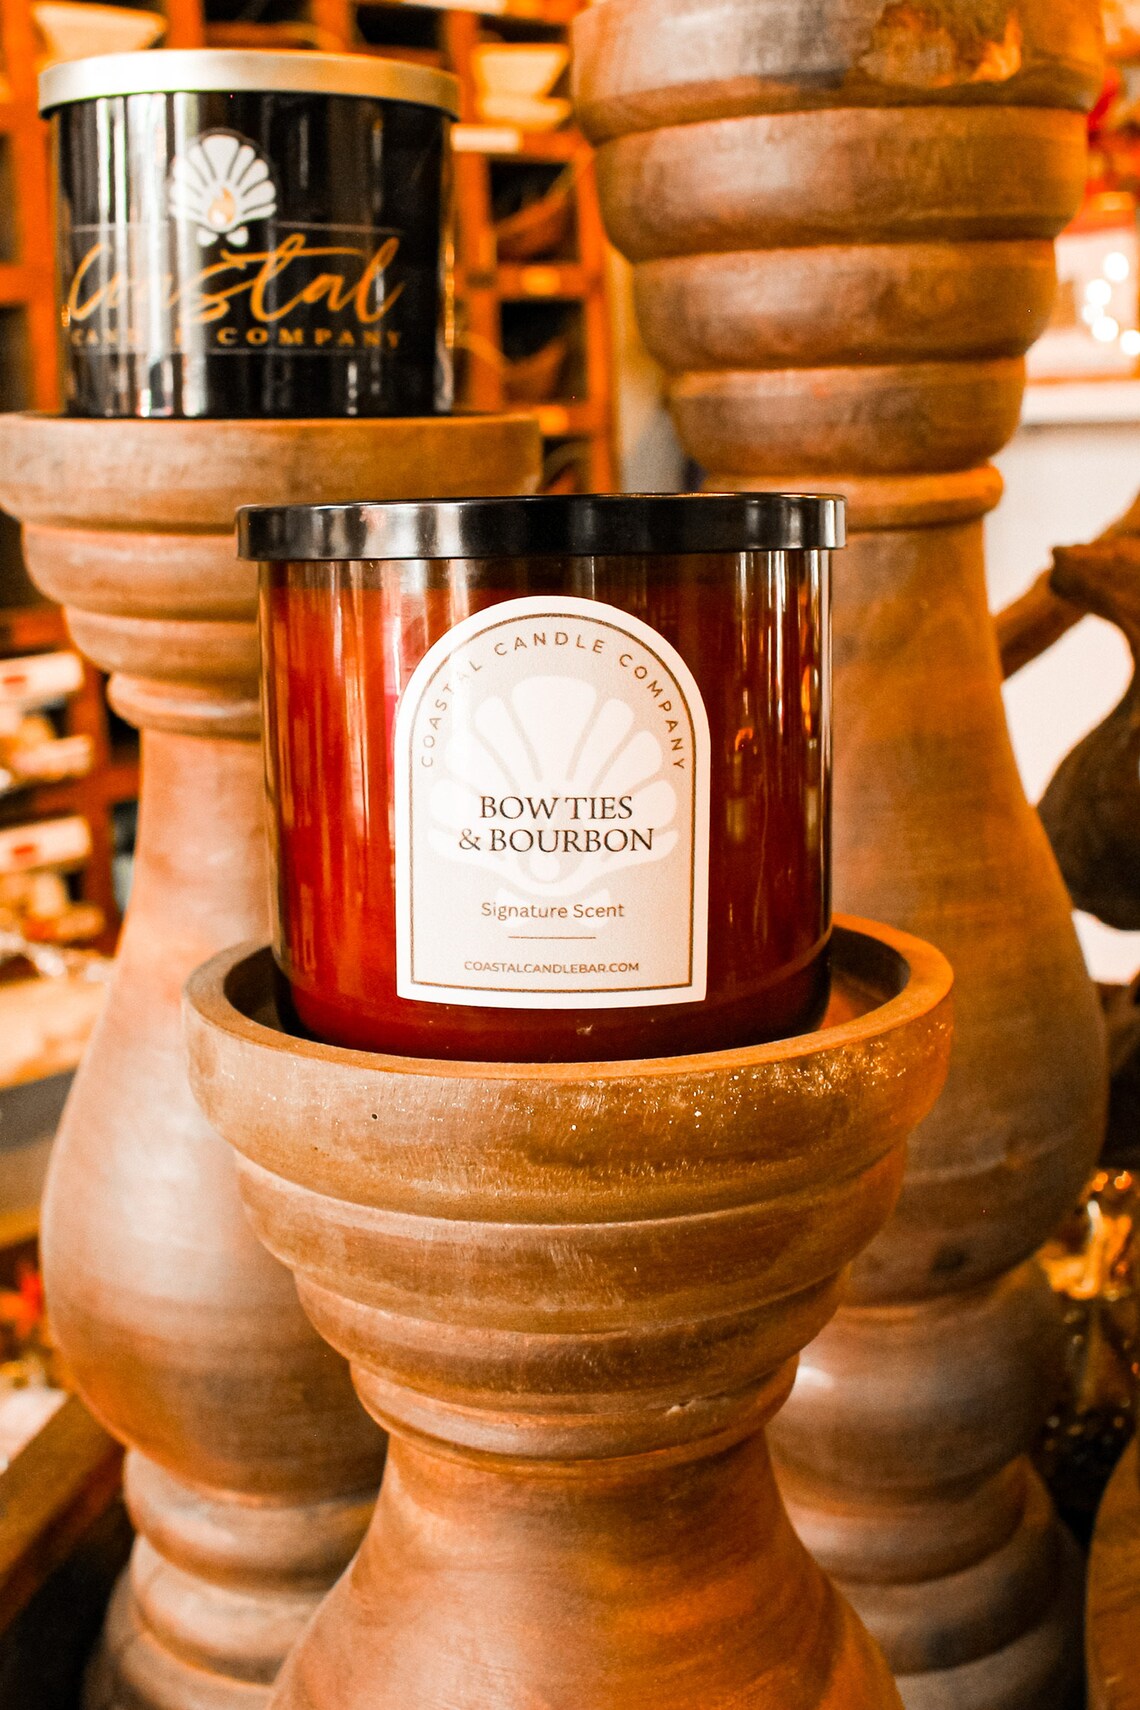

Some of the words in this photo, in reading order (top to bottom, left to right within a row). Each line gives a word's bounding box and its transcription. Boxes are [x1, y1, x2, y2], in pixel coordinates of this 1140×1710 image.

[216, 326, 400, 350] COMPANY
[493, 631, 605, 656] CANDLE
[618, 653, 685, 769] COMPANY
[479, 795, 560, 820] BOW
[564, 795, 634, 820] TIES
[458, 828, 482, 851] &
[488, 828, 655, 853] BOURBON
[480, 902, 569, 921] Signature
[572, 903, 625, 919] Scent
[463, 960, 640, 975] COASTALCANDLEBAR.COM
